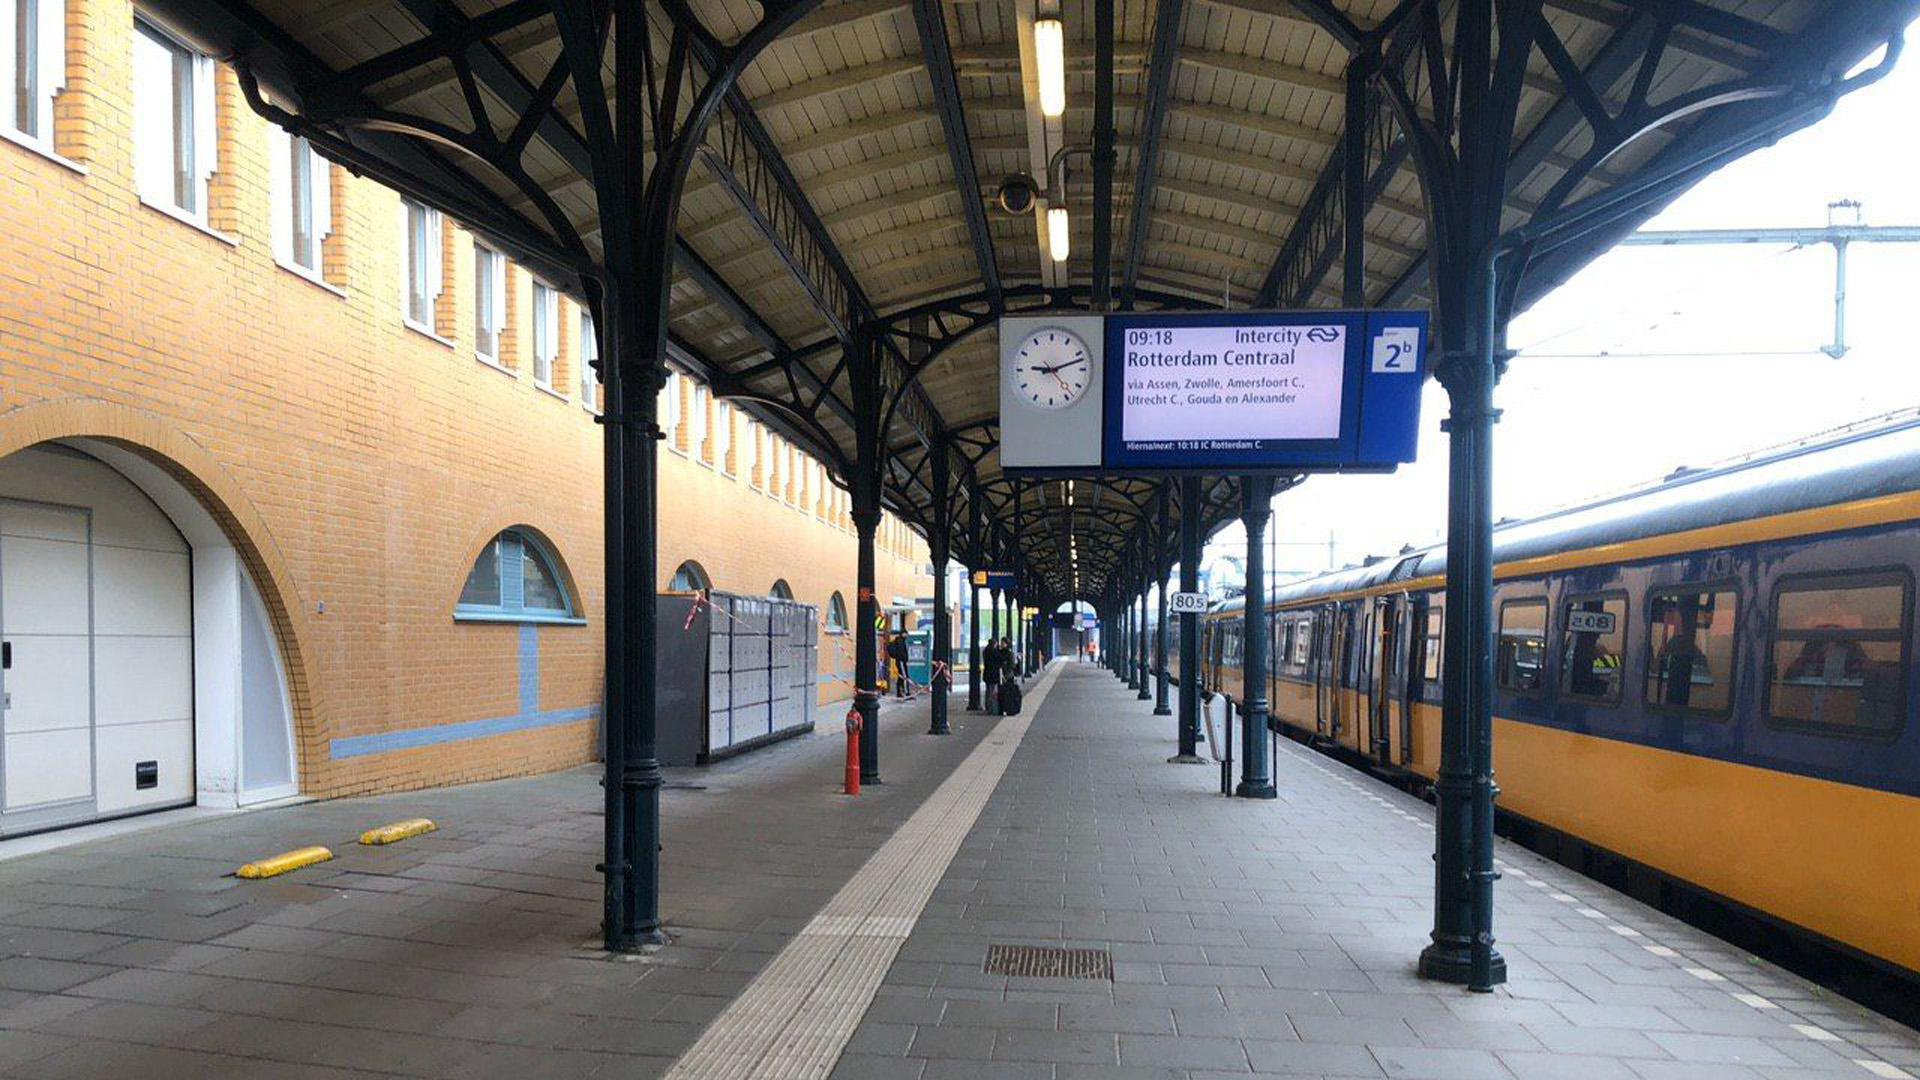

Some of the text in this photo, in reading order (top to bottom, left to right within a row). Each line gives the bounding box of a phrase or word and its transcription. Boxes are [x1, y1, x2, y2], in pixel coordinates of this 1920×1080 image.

[1129, 328, 1302, 347] 09:18 Intercity
[1128, 348, 1296, 367] Rotterdam Centraal
[1127, 376, 1306, 391] via Assen, Zwolle, Amersfoort C.,
[1127, 394, 1168, 406] Utrecht
[1187, 393, 1223, 405] Gouda
[1225, 395, 1239, 404] en
[1241, 392, 1297, 405] Alexander
[1177, 441, 1199, 451] 10:18
[1201, 441, 1210, 450] IC
[1211, 440, 1254, 450] Rotterdam
[1255, 440, 1264, 449] C.
